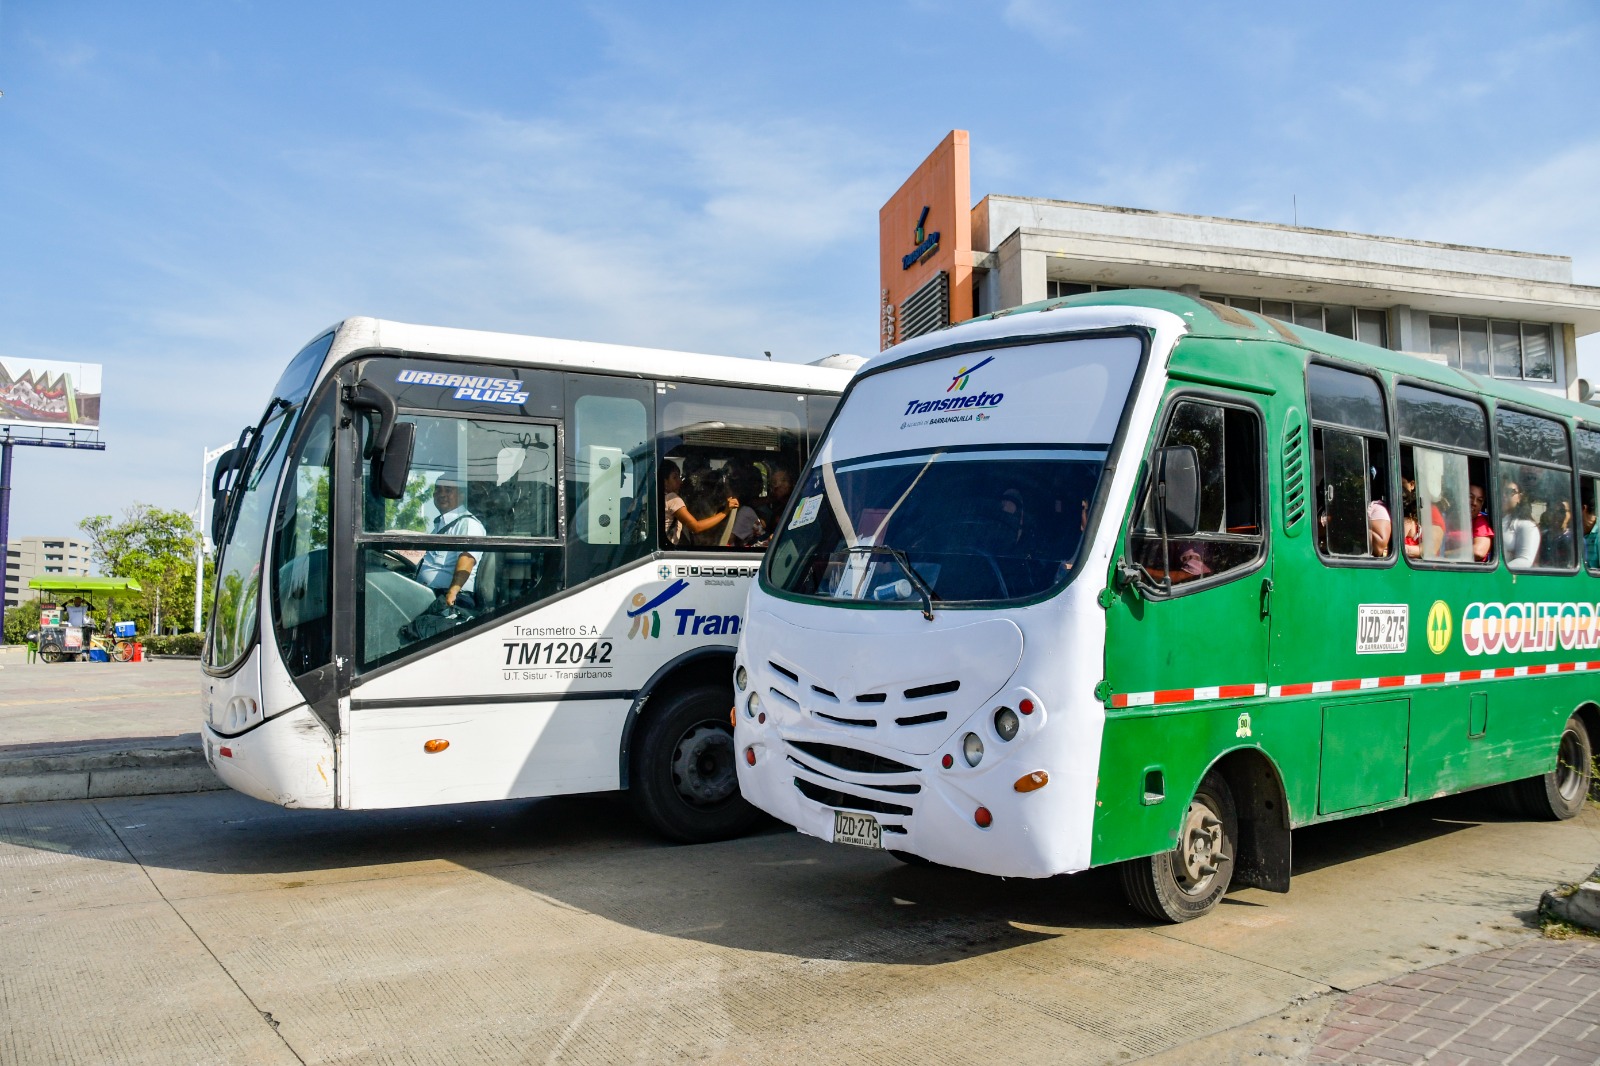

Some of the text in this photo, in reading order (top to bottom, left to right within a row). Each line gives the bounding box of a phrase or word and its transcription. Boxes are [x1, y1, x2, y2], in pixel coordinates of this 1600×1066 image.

[397, 369, 524, 392] URBANUSS
[454, 387, 529, 404] PLUSS
[904, 391, 1004, 416] Transmetro
[514, 625, 602, 636] Transmetro S.A.
[674, 608, 743, 636] Tran
[503, 641, 613, 665] TM12042
[503, 672, 520, 680] U.T.
[522, 671, 547, 680] Sistur
[555, 670, 612, 680] Transurbanos
